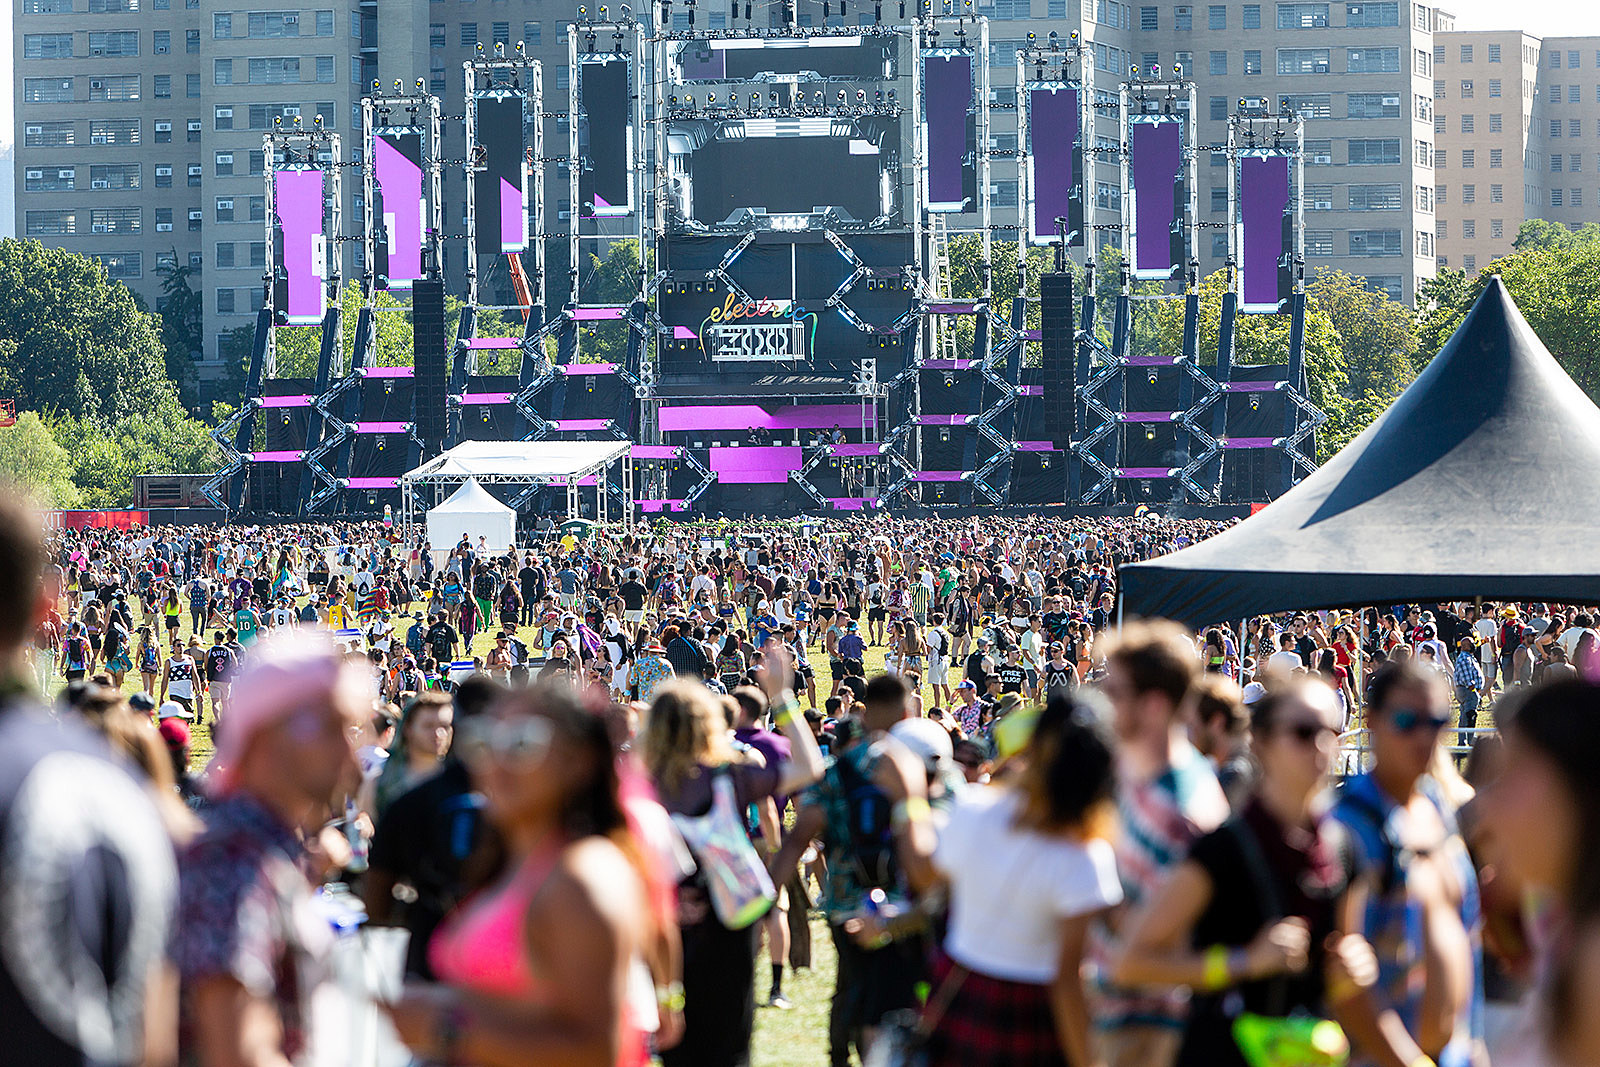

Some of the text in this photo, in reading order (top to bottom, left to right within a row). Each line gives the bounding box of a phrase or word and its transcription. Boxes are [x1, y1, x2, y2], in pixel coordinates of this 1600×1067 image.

[709, 292, 808, 323] electric
[277, 614, 285, 625] 6
[332, 615, 339, 626] 2
[239, 621, 251, 631] 10
